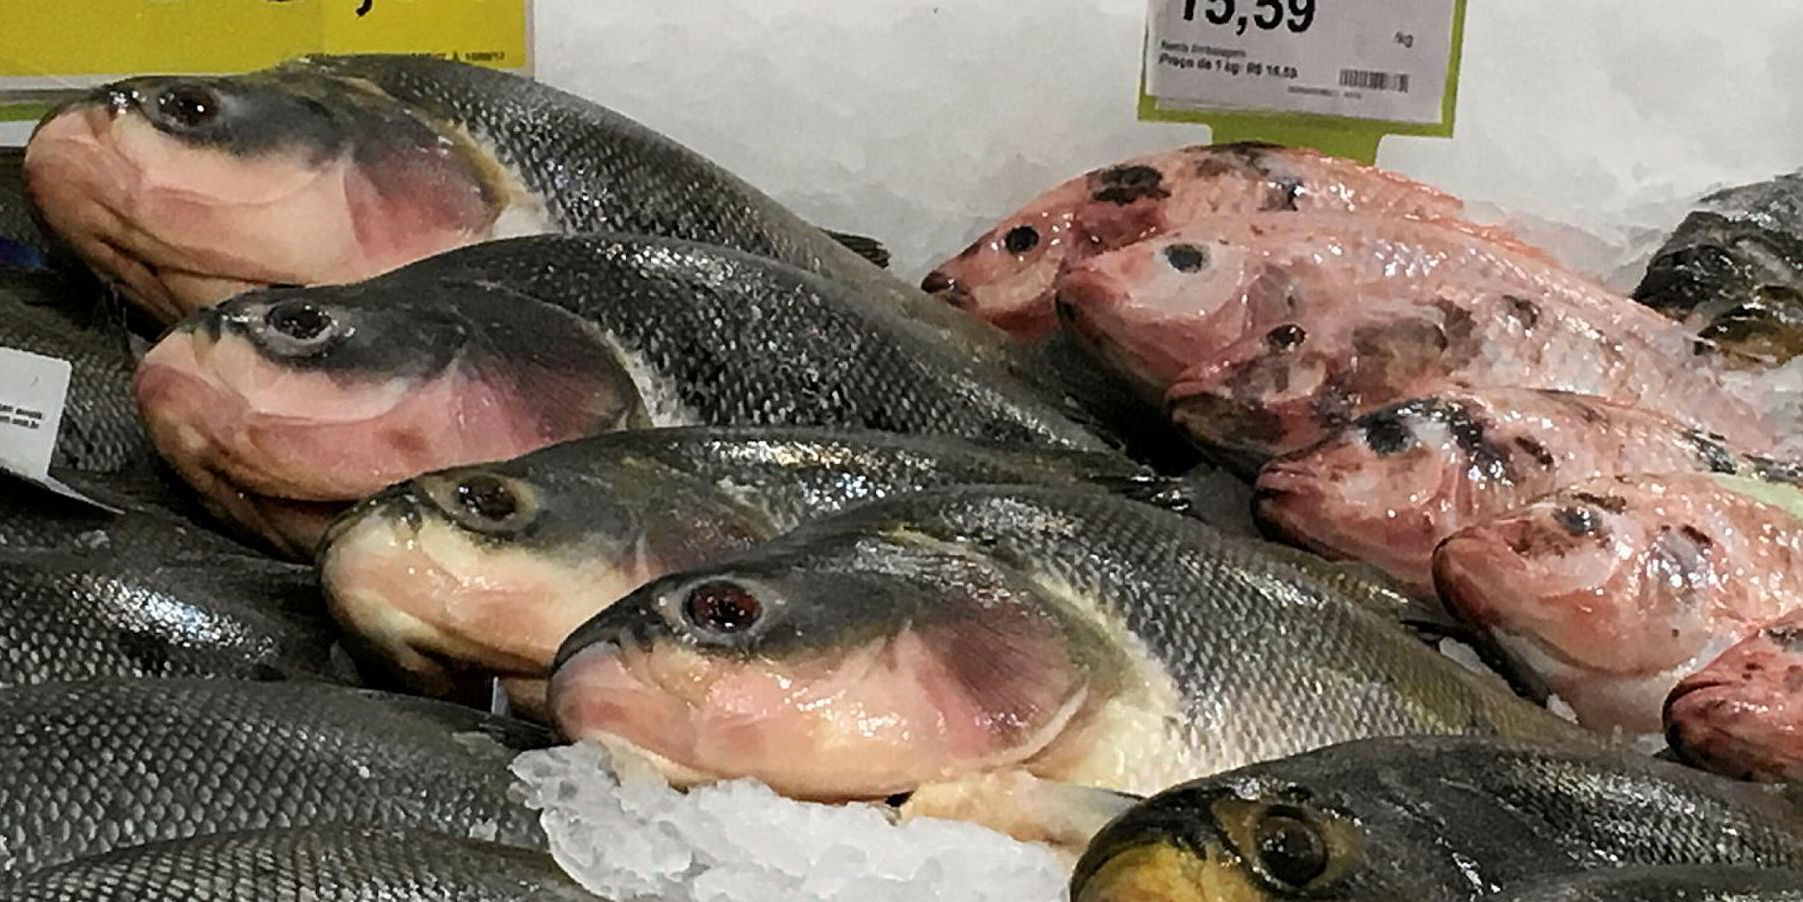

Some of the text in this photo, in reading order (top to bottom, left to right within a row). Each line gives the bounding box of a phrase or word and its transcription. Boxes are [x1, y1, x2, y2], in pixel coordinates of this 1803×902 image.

[1158, 53, 1194, 69] Preço
[1197, 57, 1212, 70] de
[1246, 62, 1262, 76] R$
